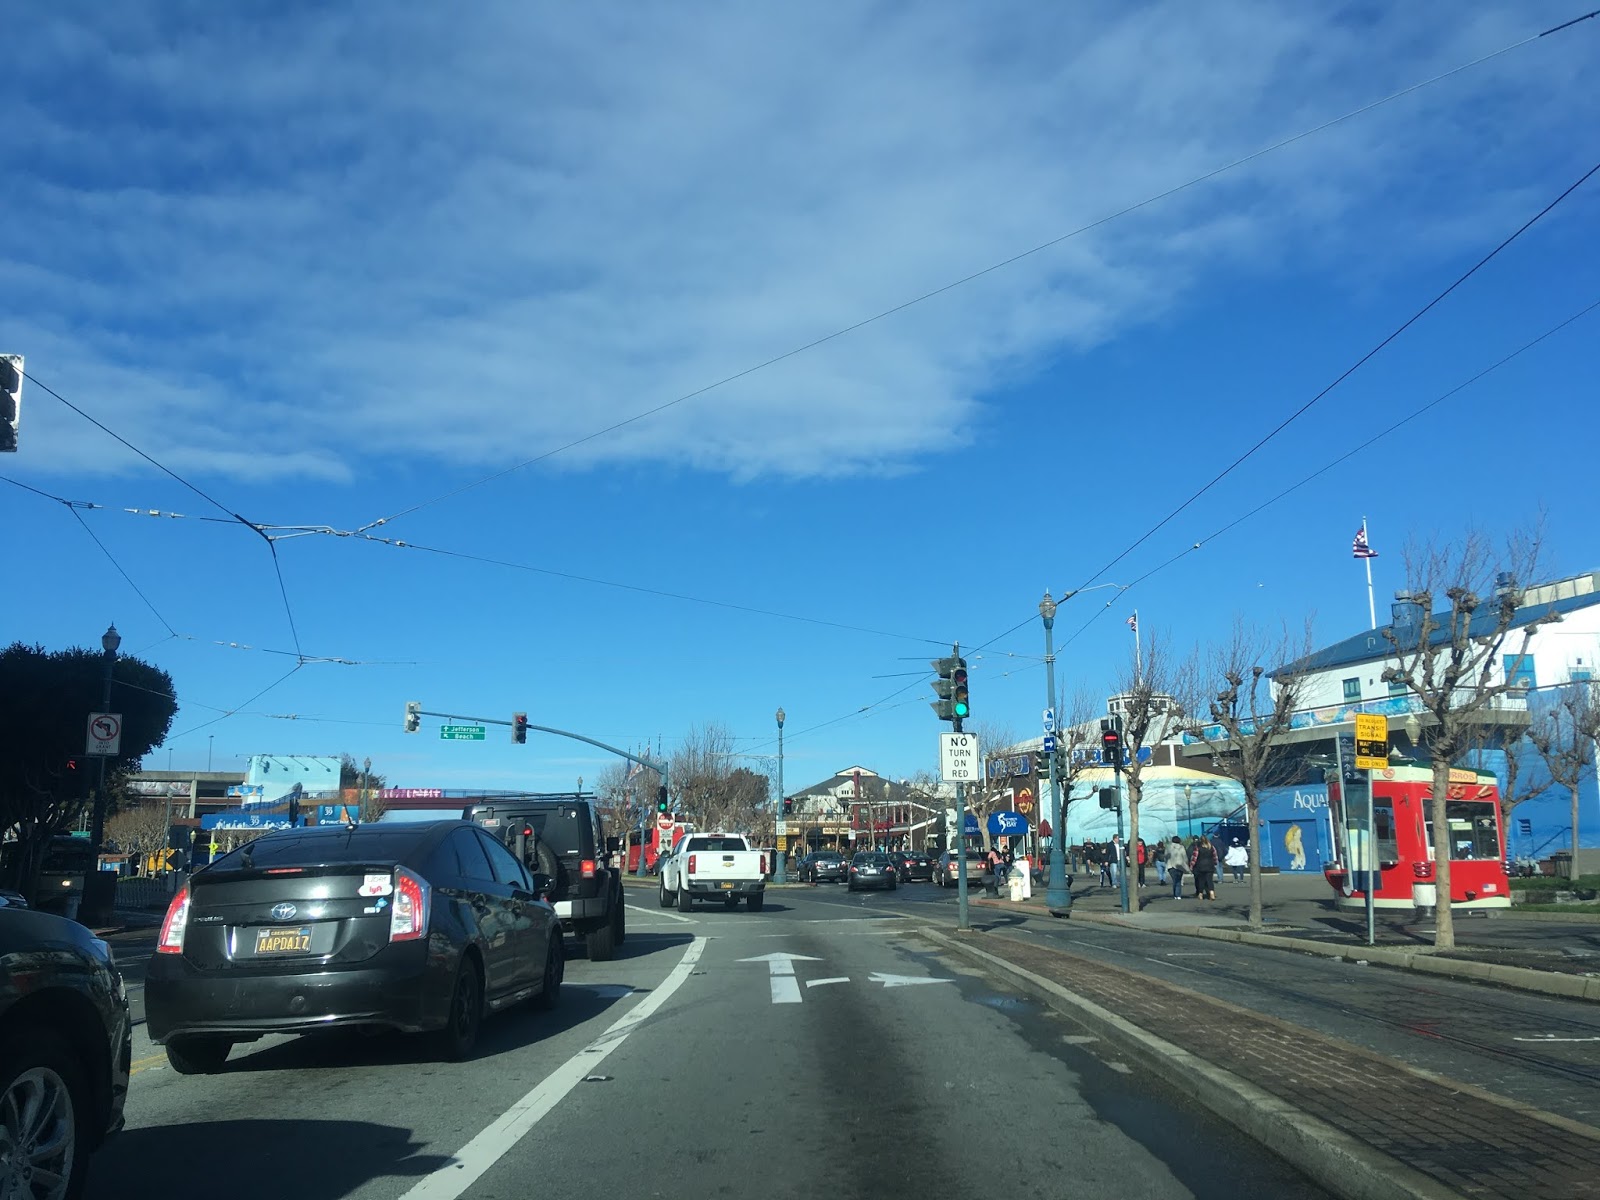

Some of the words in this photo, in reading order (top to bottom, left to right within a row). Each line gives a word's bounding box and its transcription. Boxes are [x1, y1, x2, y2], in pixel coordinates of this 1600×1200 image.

[950, 737, 968, 747] NO
[949, 749, 971, 757] TURN
[953, 759, 967, 767] ON
[952, 769, 969, 778] RED
[1450, 771, 1475, 780] RROS
[250, 818, 260, 826] 39
[259, 935, 310, 952] AAPDA17
